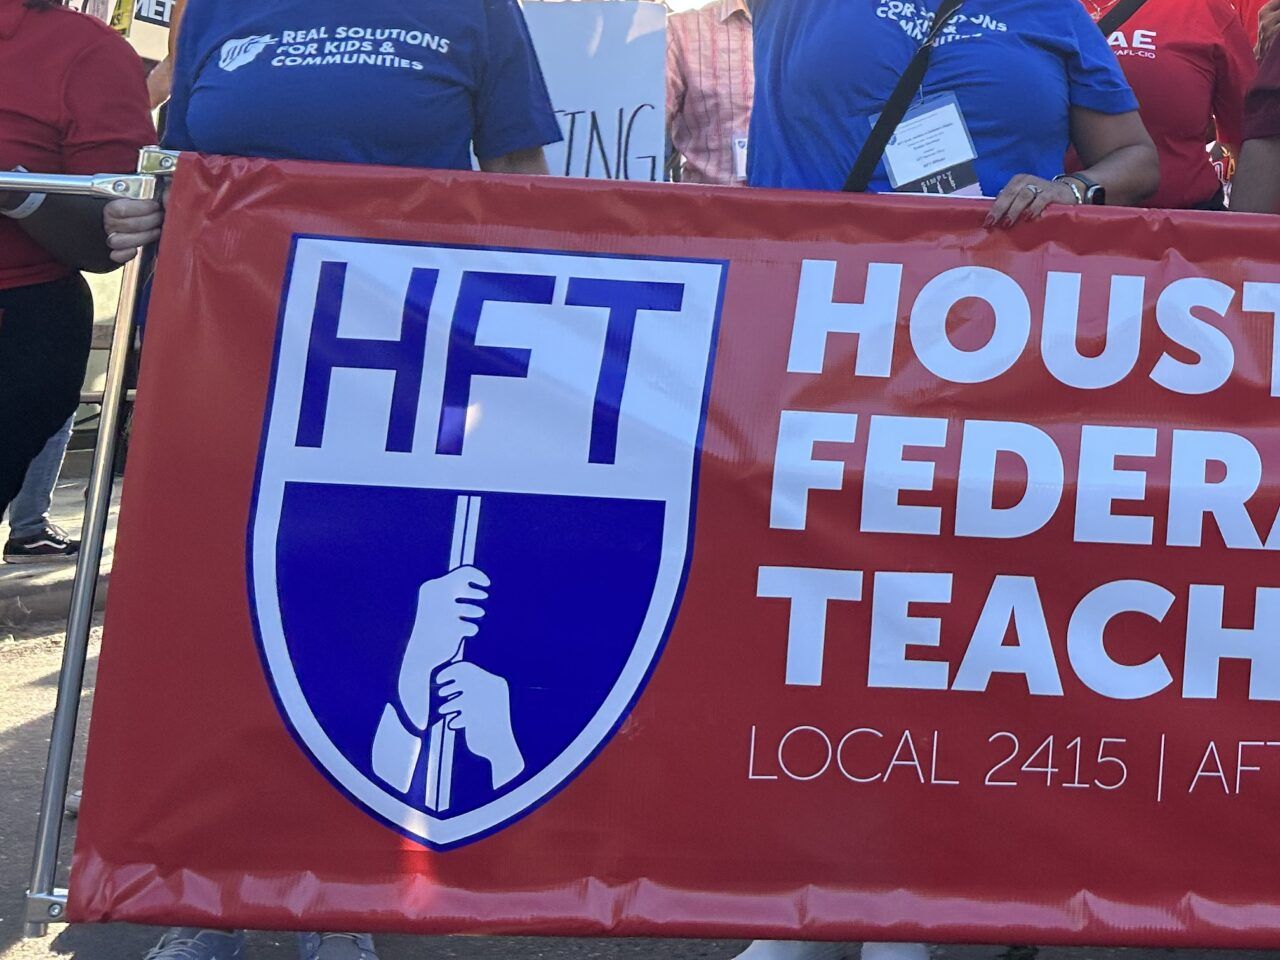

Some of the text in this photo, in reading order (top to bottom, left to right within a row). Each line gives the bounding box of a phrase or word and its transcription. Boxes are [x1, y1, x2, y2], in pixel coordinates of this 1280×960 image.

[276, 40, 396, 55] FOR KIDS &
[282, 26, 451, 54] REAL SOLUTIONS
[270, 53, 424, 70] COMMUNITIES
[295, 260, 684, 465] HFT
[748, 725, 959, 785] LOCAL
[985, 731, 1128, 790] 2415
